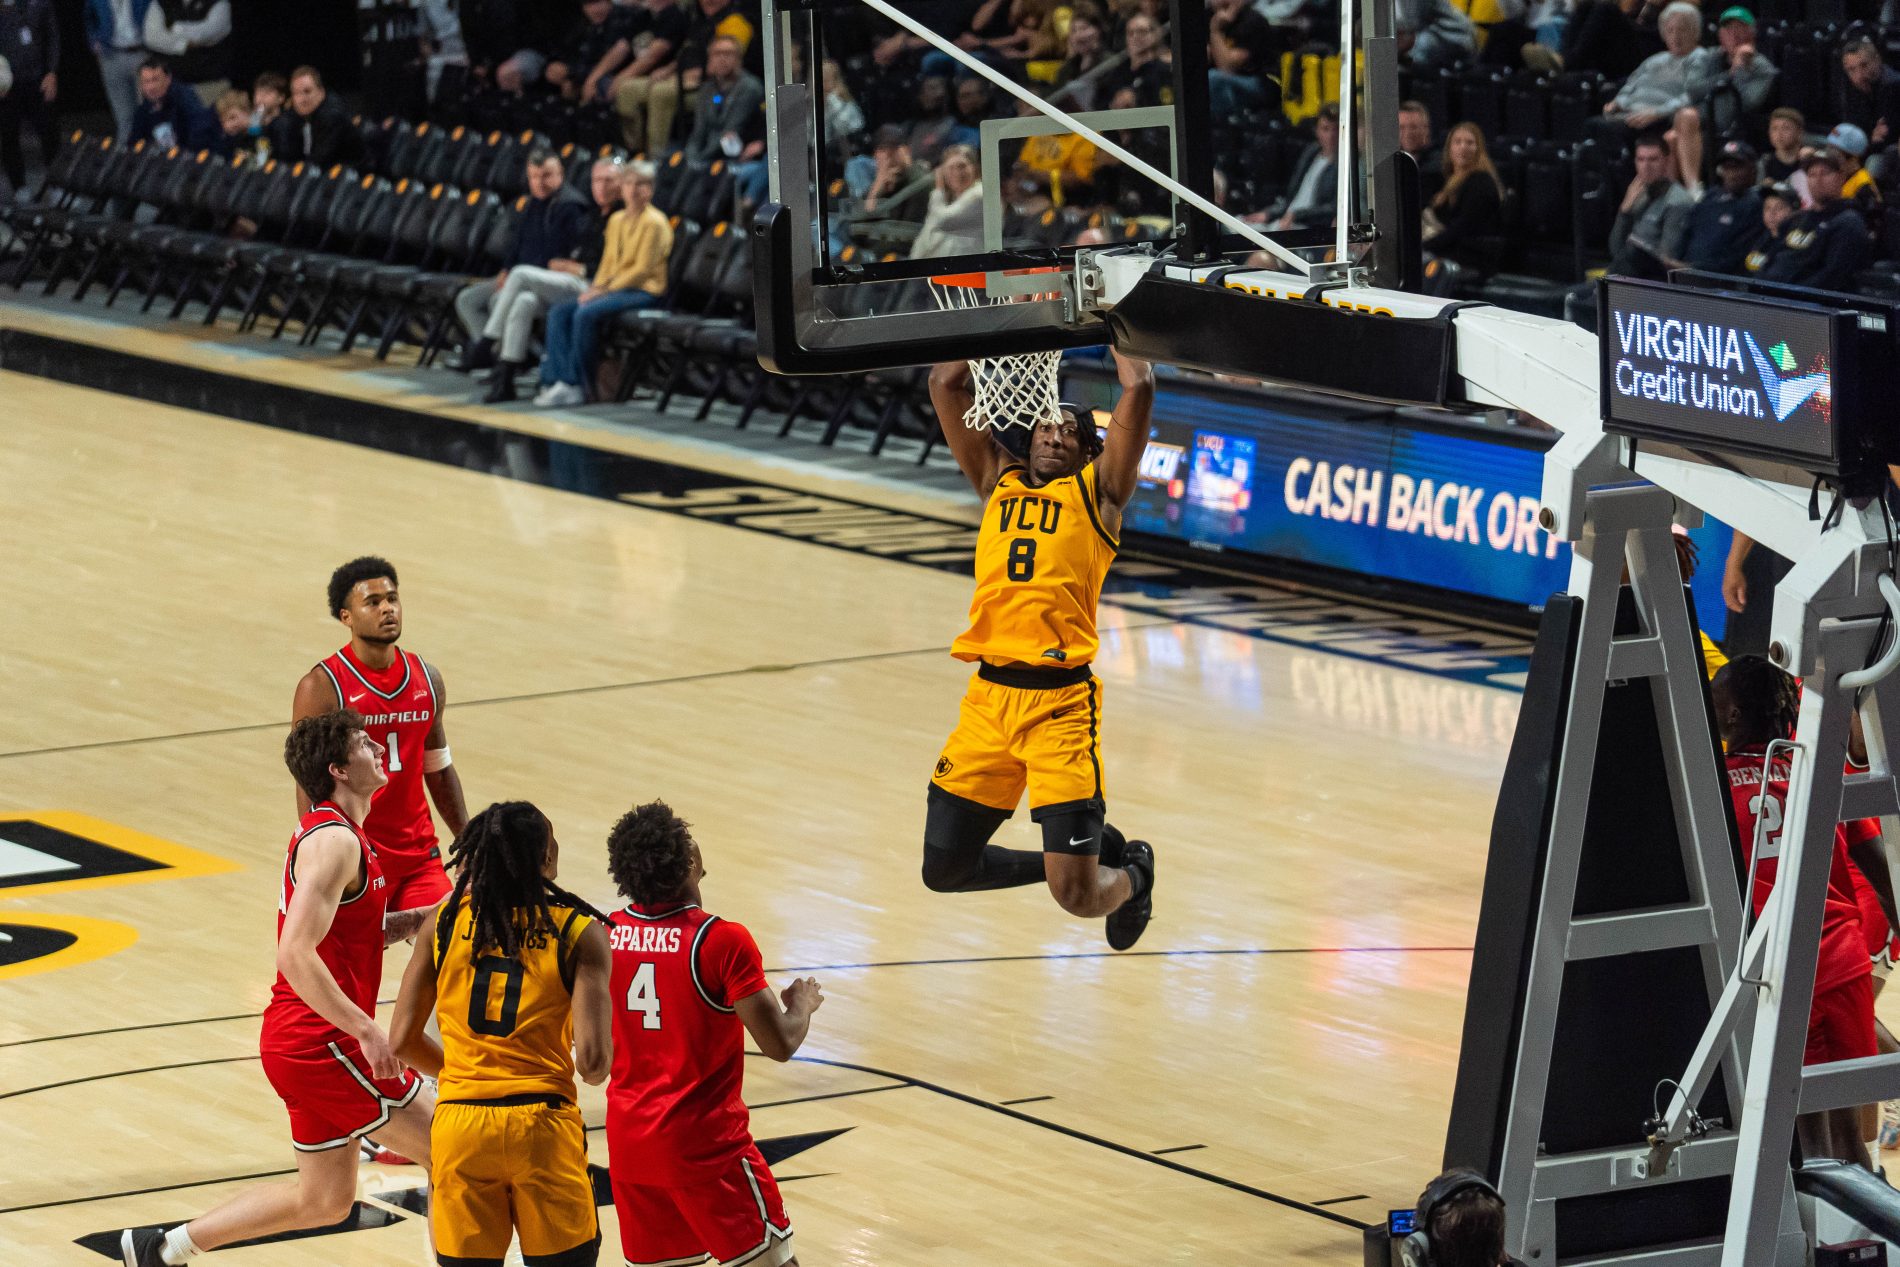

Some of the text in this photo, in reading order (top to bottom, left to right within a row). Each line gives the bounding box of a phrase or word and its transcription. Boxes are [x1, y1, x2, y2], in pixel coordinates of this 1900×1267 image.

[1614, 311, 1745, 374] VIRGINIA
[1615, 358, 1687, 405] Credit
[1140, 443, 1180, 481] VCU
[1000, 496, 1062, 534] VCU
[1284, 456, 1540, 558] CASH BACK OR
[1007, 537, 1037, 582] 8
[364, 710, 430, 726] AIRFIELD
[386, 731, 402, 773] 1
[610, 925, 682, 953] SPARKS
[467, 955, 525, 1038] 0
[626, 962, 661, 1031] 4
